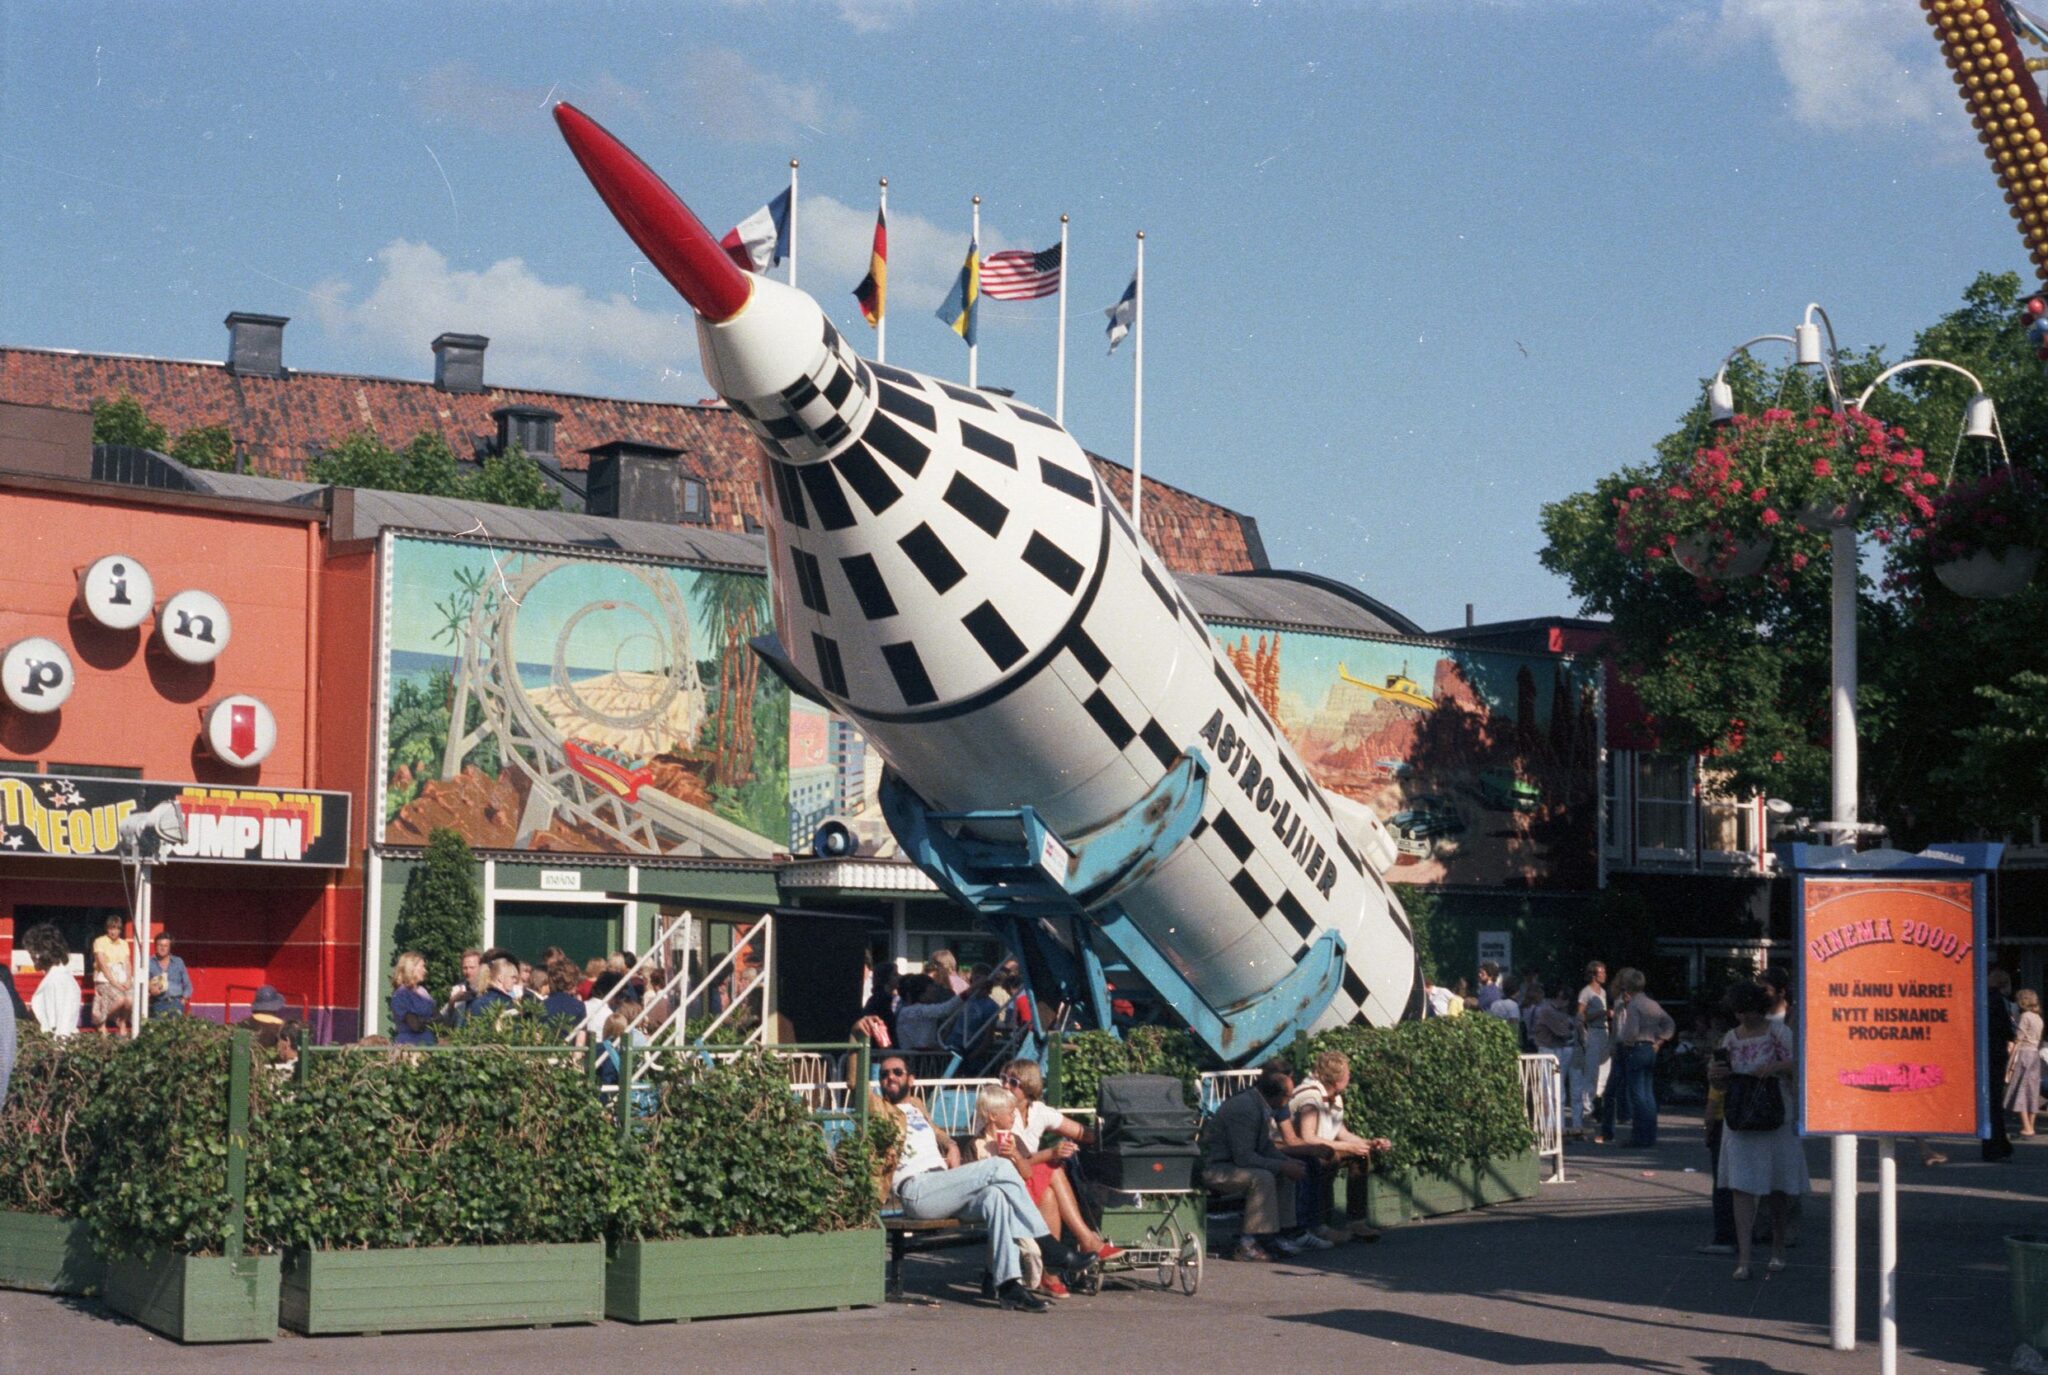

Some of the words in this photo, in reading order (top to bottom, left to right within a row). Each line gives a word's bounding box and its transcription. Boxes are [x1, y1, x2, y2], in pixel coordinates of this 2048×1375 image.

[1199, 707, 1338, 902] ASTRO-LINER
[1808, 918, 1894, 962] CINEMA
[1902, 919, 1972, 964] 2000!
[1829, 983, 1848, 997] NU
[1853, 979, 1893, 997] ÄNNU
[1898, 979, 1952, 998] VÄRRE!
[1832, 1007, 1868, 1022] NYTT
[1874, 1008, 1949, 1023] HISNANDE
[1849, 1025, 1931, 1040] PROGRAM!
